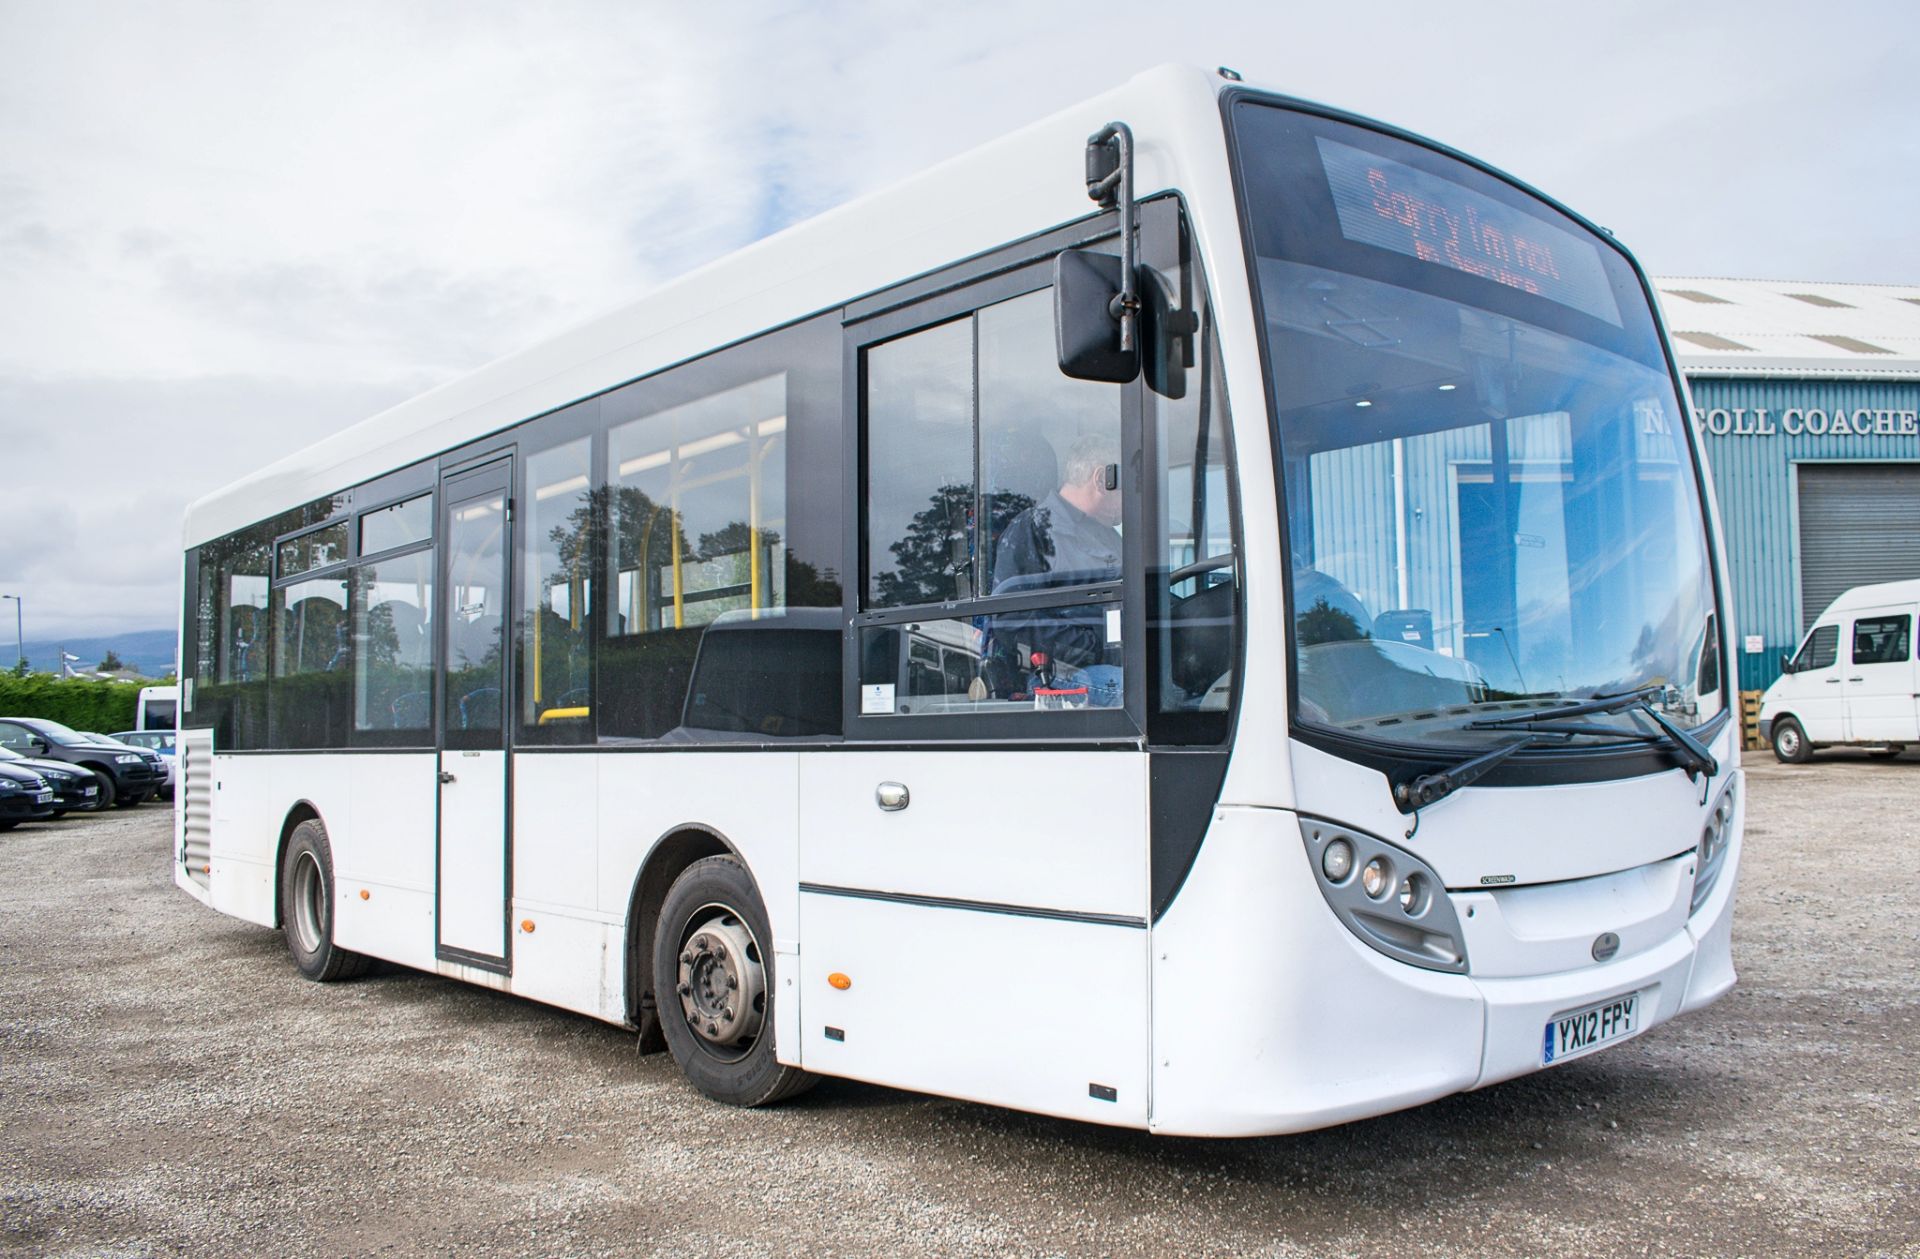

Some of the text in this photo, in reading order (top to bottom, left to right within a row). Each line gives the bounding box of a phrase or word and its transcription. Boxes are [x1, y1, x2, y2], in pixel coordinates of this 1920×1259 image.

[1368, 168, 1460, 245] Sorry
[1559, 999, 1633, 1052] YX12 FPY
